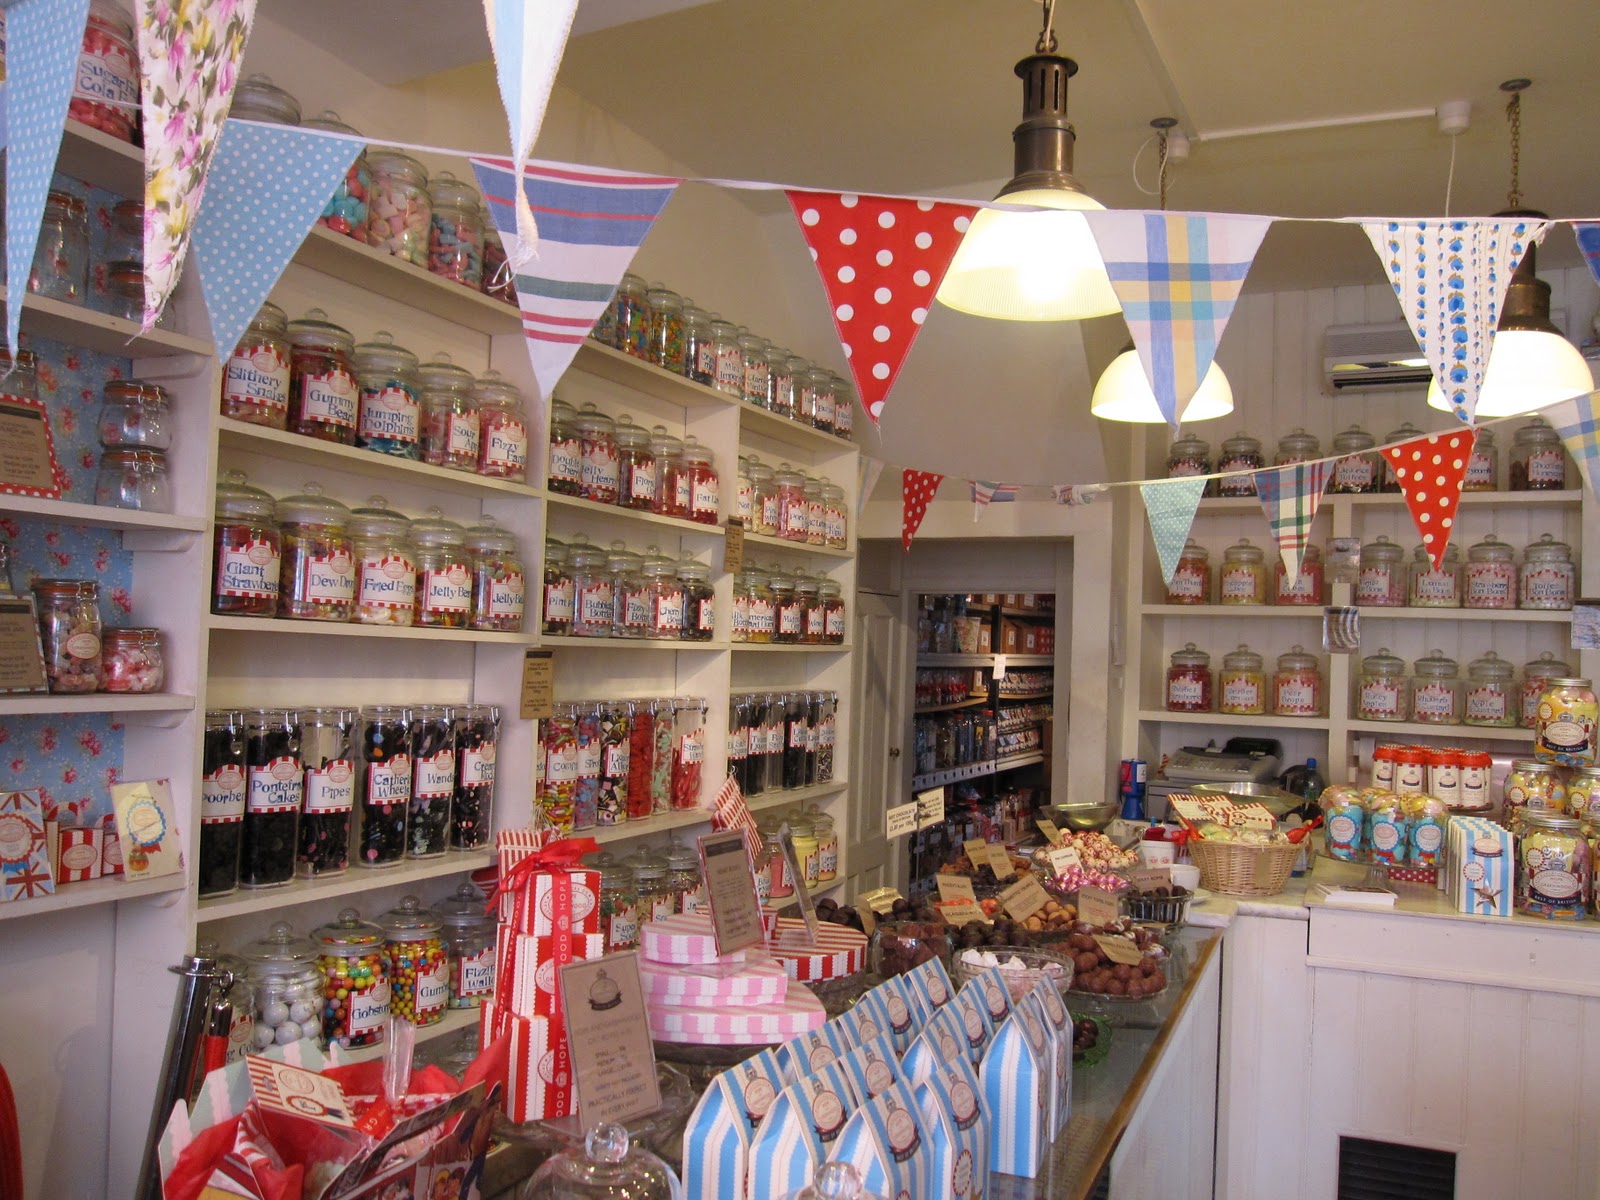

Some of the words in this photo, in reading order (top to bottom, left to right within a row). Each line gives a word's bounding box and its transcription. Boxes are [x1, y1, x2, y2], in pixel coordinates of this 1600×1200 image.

[80, 60, 125, 88] Sugar
[80, 76, 115, 100] Cola
[228, 367, 283, 389] Slithery
[246, 382, 287, 404] Snakes
[310, 389, 356, 410] Gummy
[364, 407, 414, 426] Jumping
[363, 417, 415, 437] Dolphins
[453, 425, 477, 440] Sour
[491, 438, 520, 453] Fizzy
[225, 562, 265, 579] Giant
[311, 574, 338, 588] Dew
[364, 577, 396, 593] Fried
[430, 585, 458, 601] Jelly
[492, 593, 515, 607] Jelly
[268, 792, 300, 804] Cakes
[321, 785, 351, 800] Pipes
[377, 783, 410, 798] Wheels
[559, 879, 568, 911] HOPE
[559, 1037, 568, 1069] HOPE
